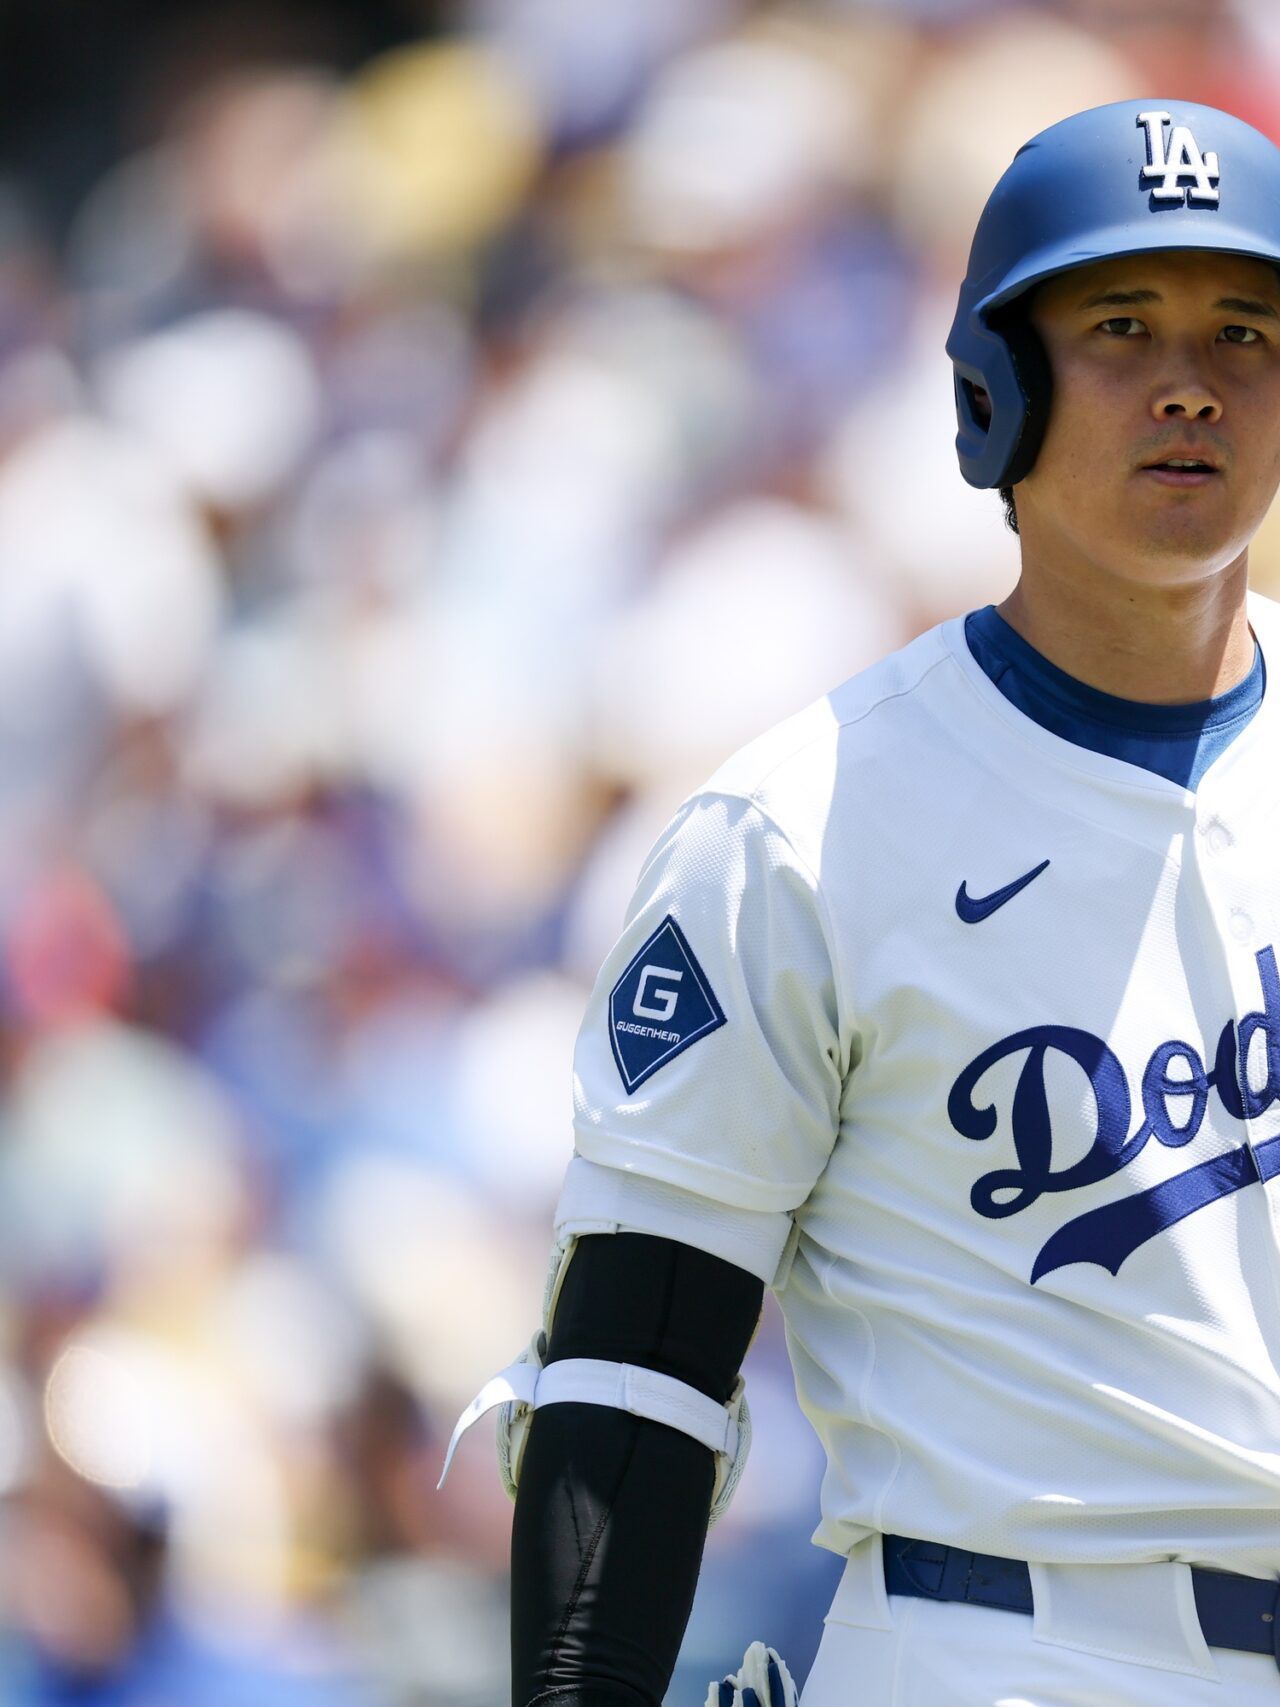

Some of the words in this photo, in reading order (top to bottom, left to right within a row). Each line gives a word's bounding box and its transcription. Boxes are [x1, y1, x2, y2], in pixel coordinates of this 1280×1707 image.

[1137, 111, 1219, 201] LA
[632, 964, 684, 1022] G
[616, 1021, 681, 1043] GUGGENHEIM
